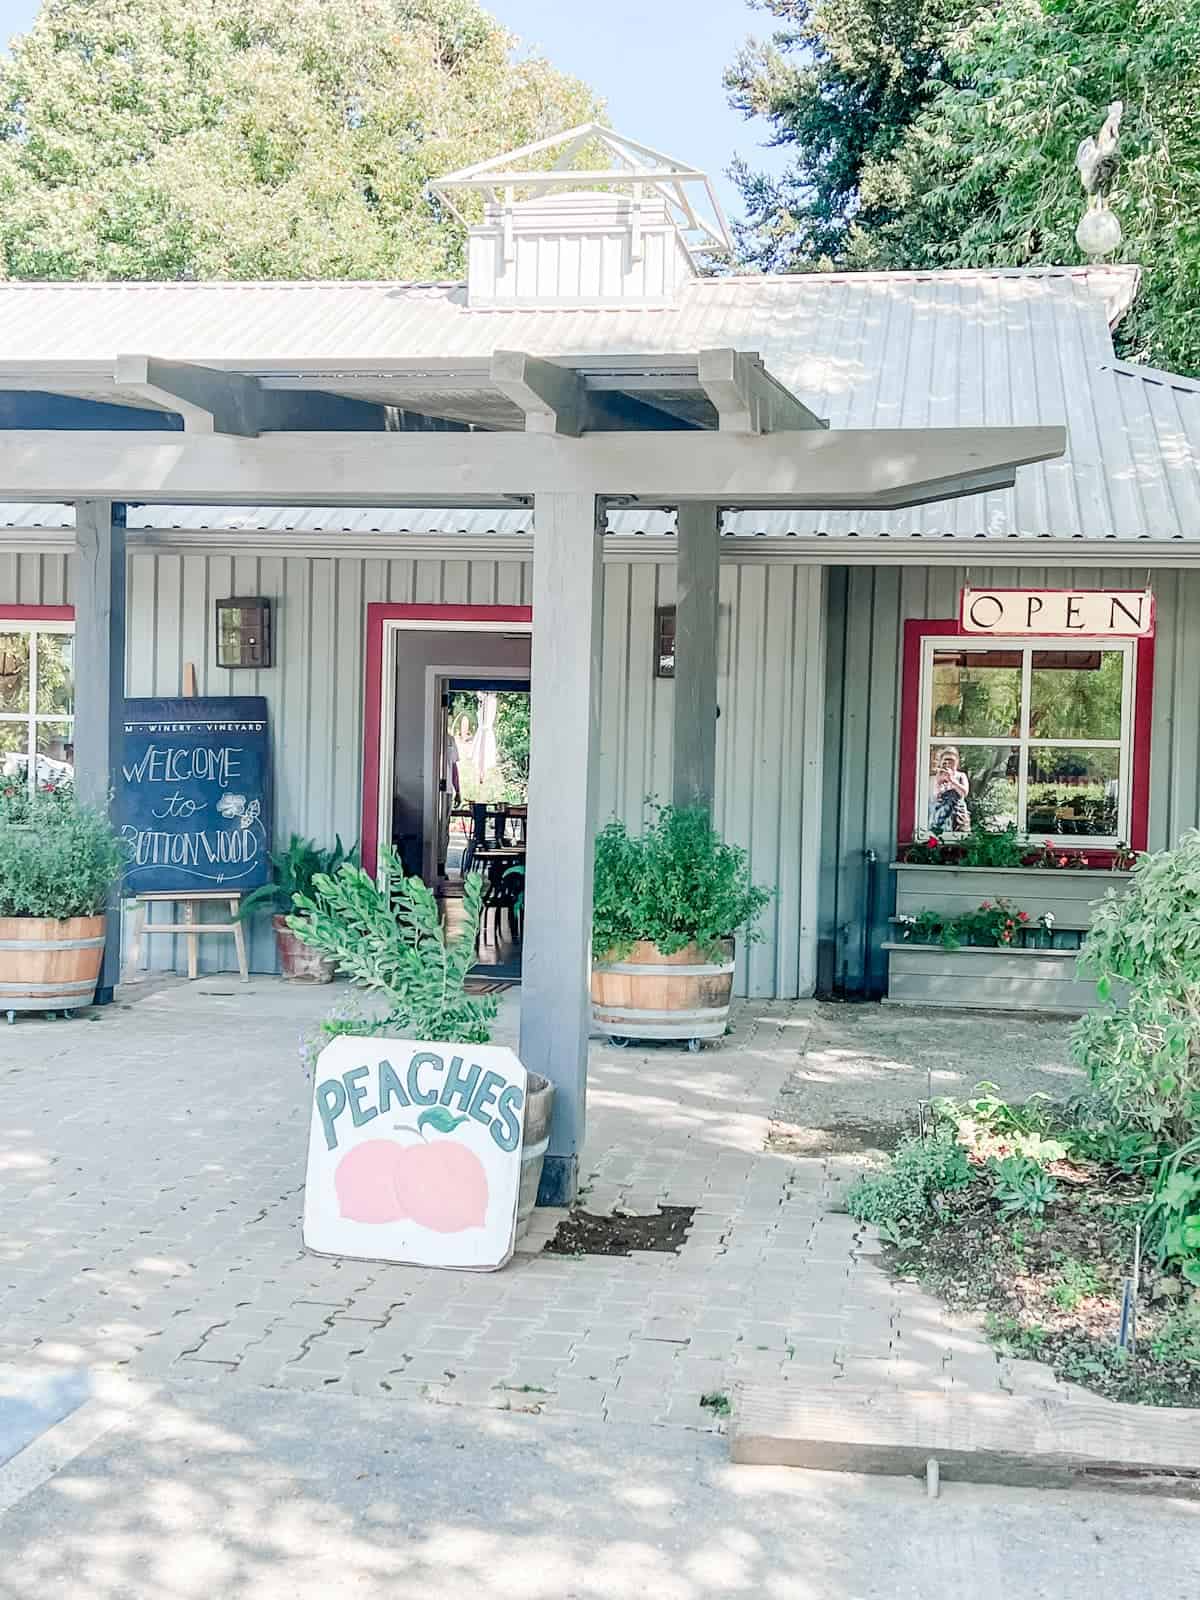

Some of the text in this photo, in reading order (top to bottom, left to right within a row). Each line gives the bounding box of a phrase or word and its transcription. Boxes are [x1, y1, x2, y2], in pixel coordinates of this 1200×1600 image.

[970, 595, 1144, 629] OPEN
[149, 723, 263, 732] WINERY VINEYARD
[122, 744, 243, 788] WELCOME
[151, 791, 208, 818] to
[316, 1052, 525, 1152] PEACHES
